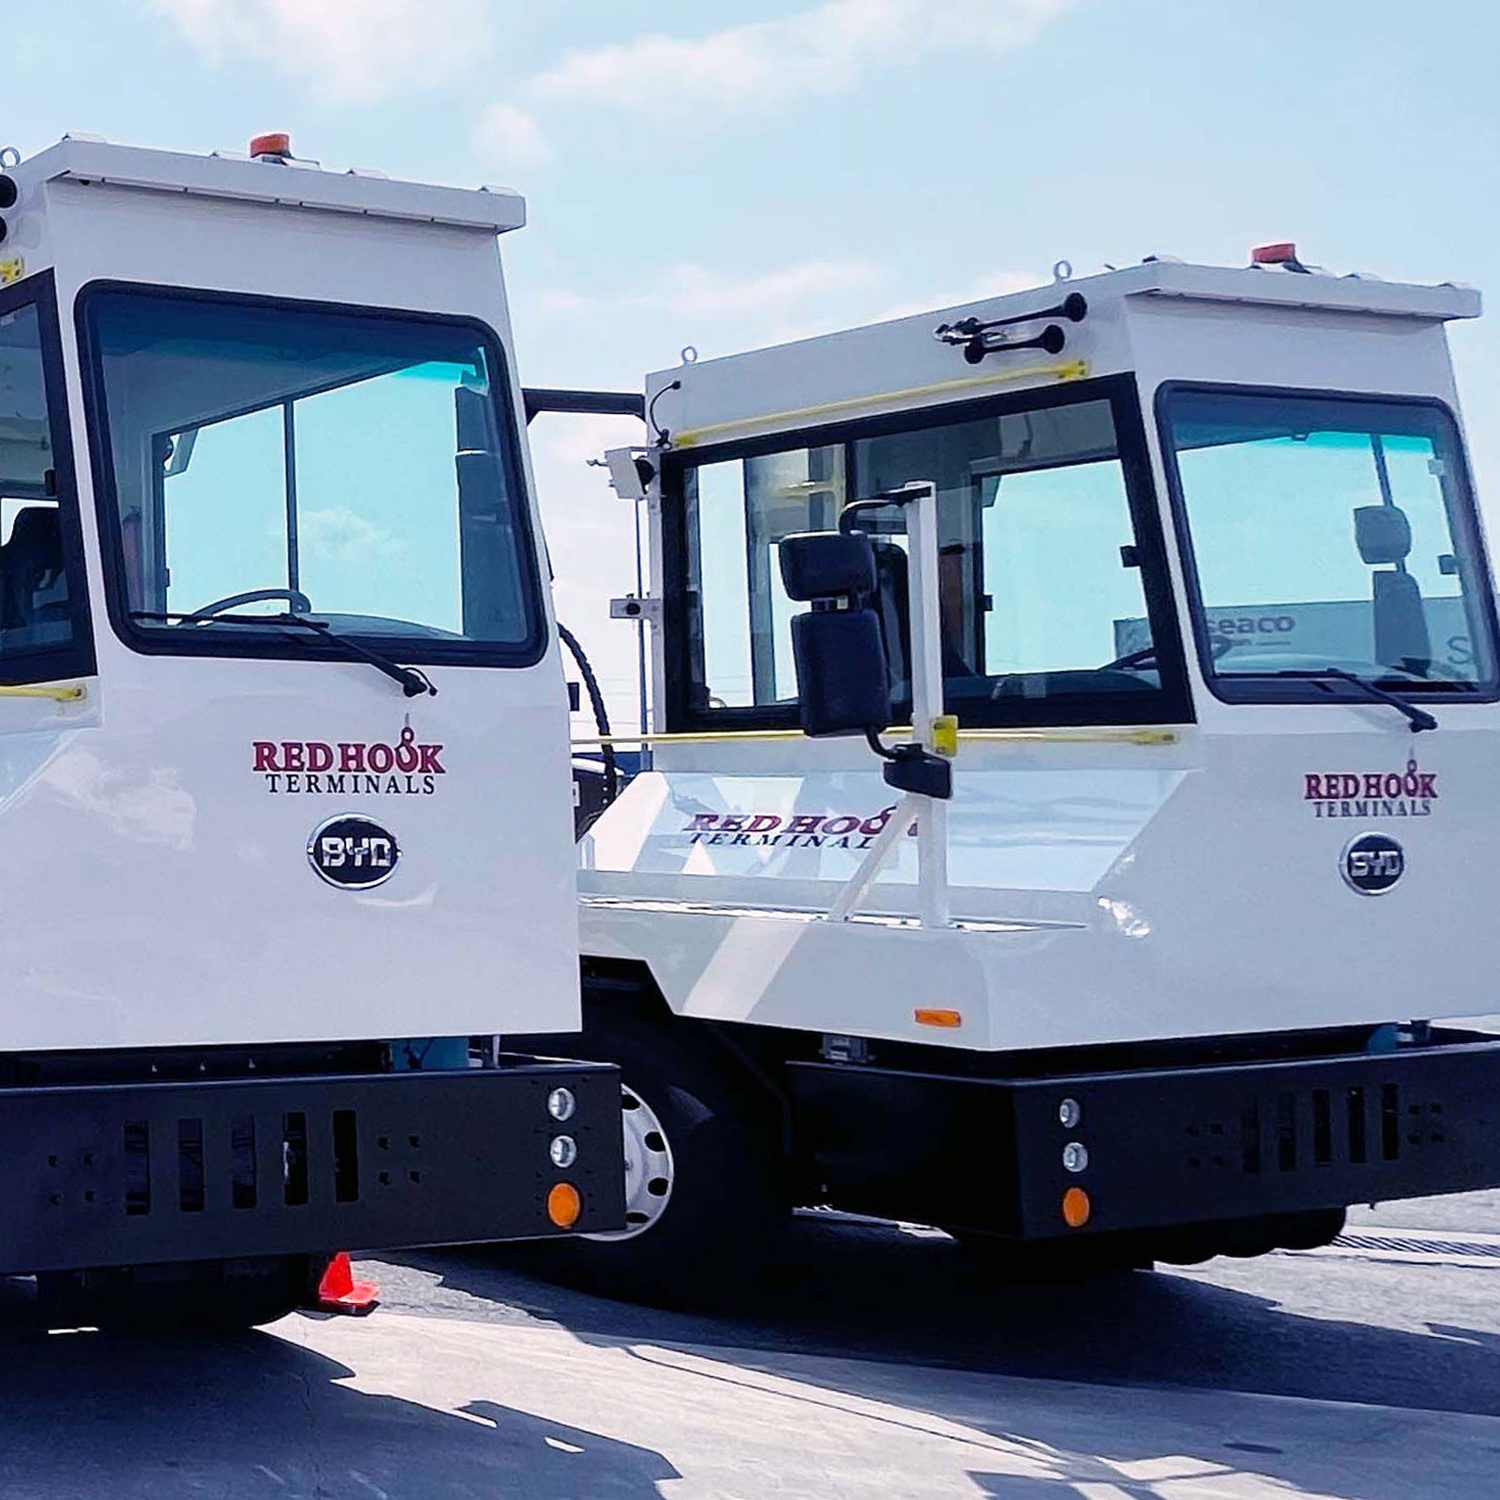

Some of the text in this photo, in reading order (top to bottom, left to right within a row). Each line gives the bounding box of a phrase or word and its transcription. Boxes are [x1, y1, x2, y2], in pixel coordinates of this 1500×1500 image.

[253, 727, 446, 774] RED HOOK
[266, 774, 435, 794] TERMINALS
[1304, 759, 1438, 799] RED HOOK
[1313, 800, 1431, 818] TERMINALS
[682, 814, 781, 833] RED
[689, 833, 873, 849] TERMINAL
[321, 837, 391, 867] BYD
